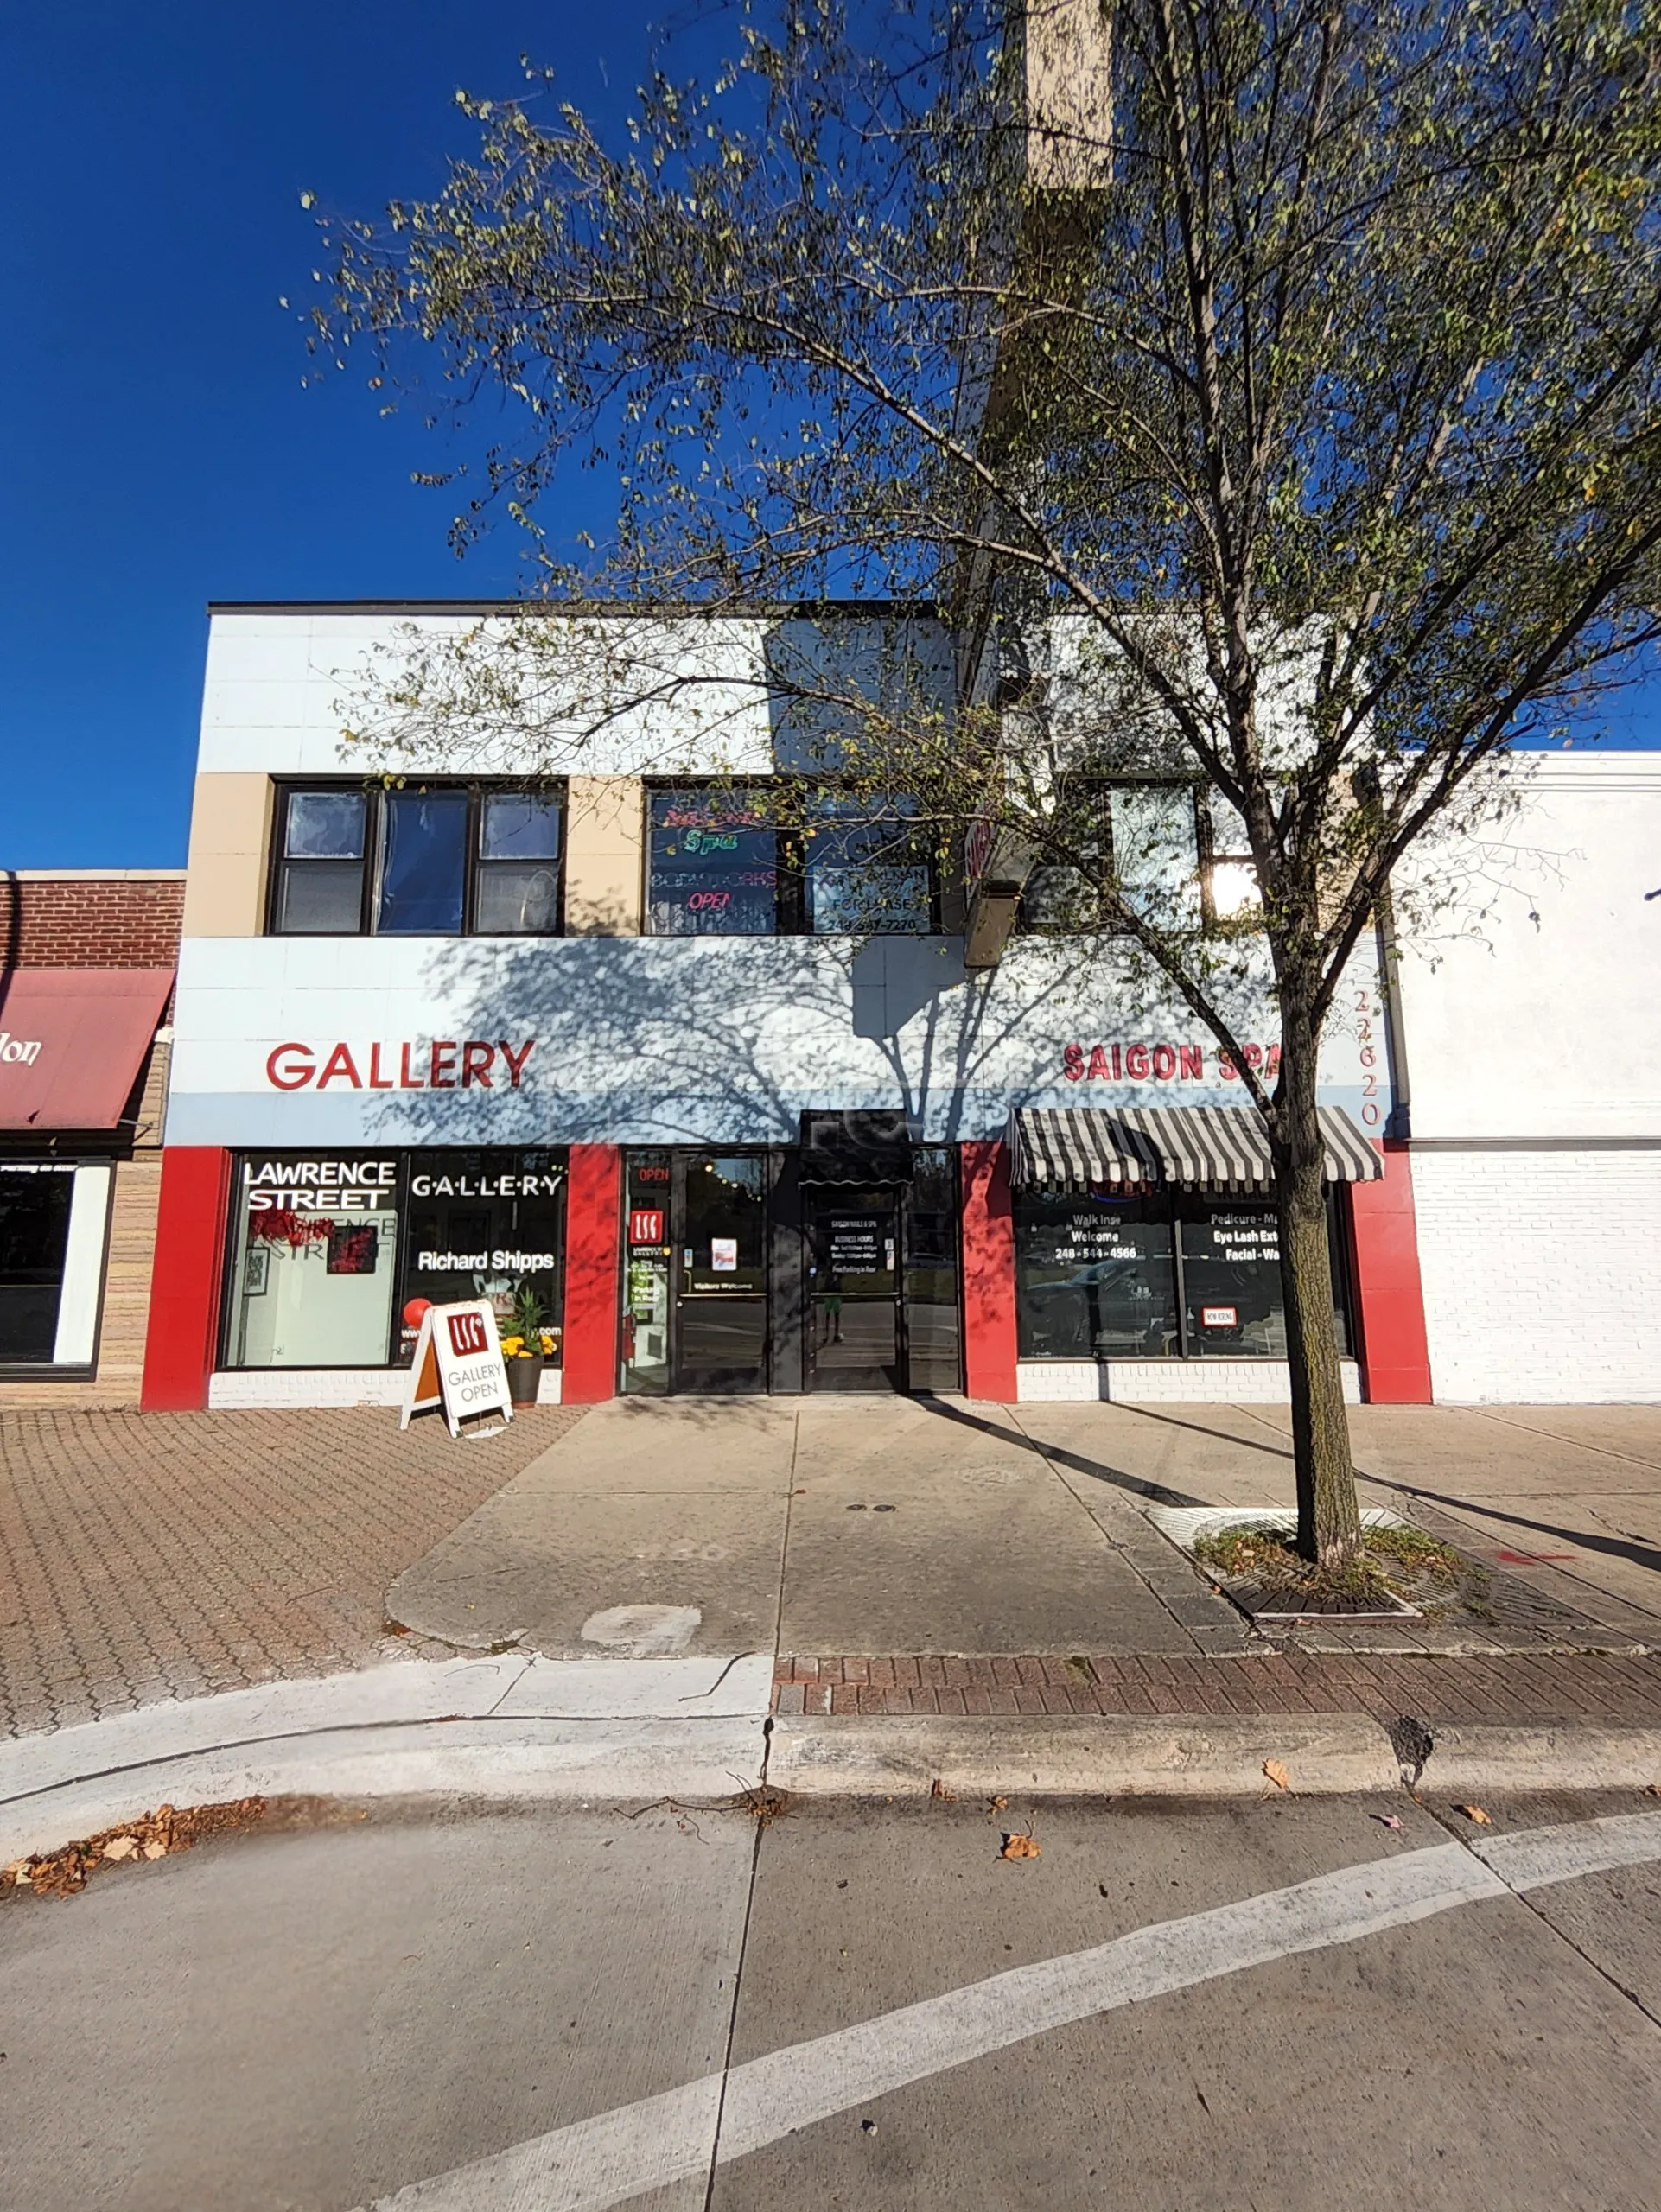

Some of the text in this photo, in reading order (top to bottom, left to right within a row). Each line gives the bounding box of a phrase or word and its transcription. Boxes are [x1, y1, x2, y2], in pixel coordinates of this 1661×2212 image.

[266, 1039, 536, 1090] GALLERY
[1063, 1043, 1204, 1081] SAIGON
[244, 1161, 397, 1185] LAWRENCE
[639, 1167, 669, 1181] OPEN
[247, 1189, 389, 1210] STREET
[1072, 1214, 1099, 1225] Walk
[1211, 1214, 1256, 1224] Pedicure
[1071, 1230, 1119, 1242] Welcome
[1213, 1230, 1232, 1244] Eye
[1234, 1230, 1258, 1242] Lash
[418, 1250, 555, 1273] Richard Shipps
[1226, 1248, 1257, 1260] Facial
[448, 1363, 501, 1386] GALLERY
[461, 1382, 499, 1402] OPEN
